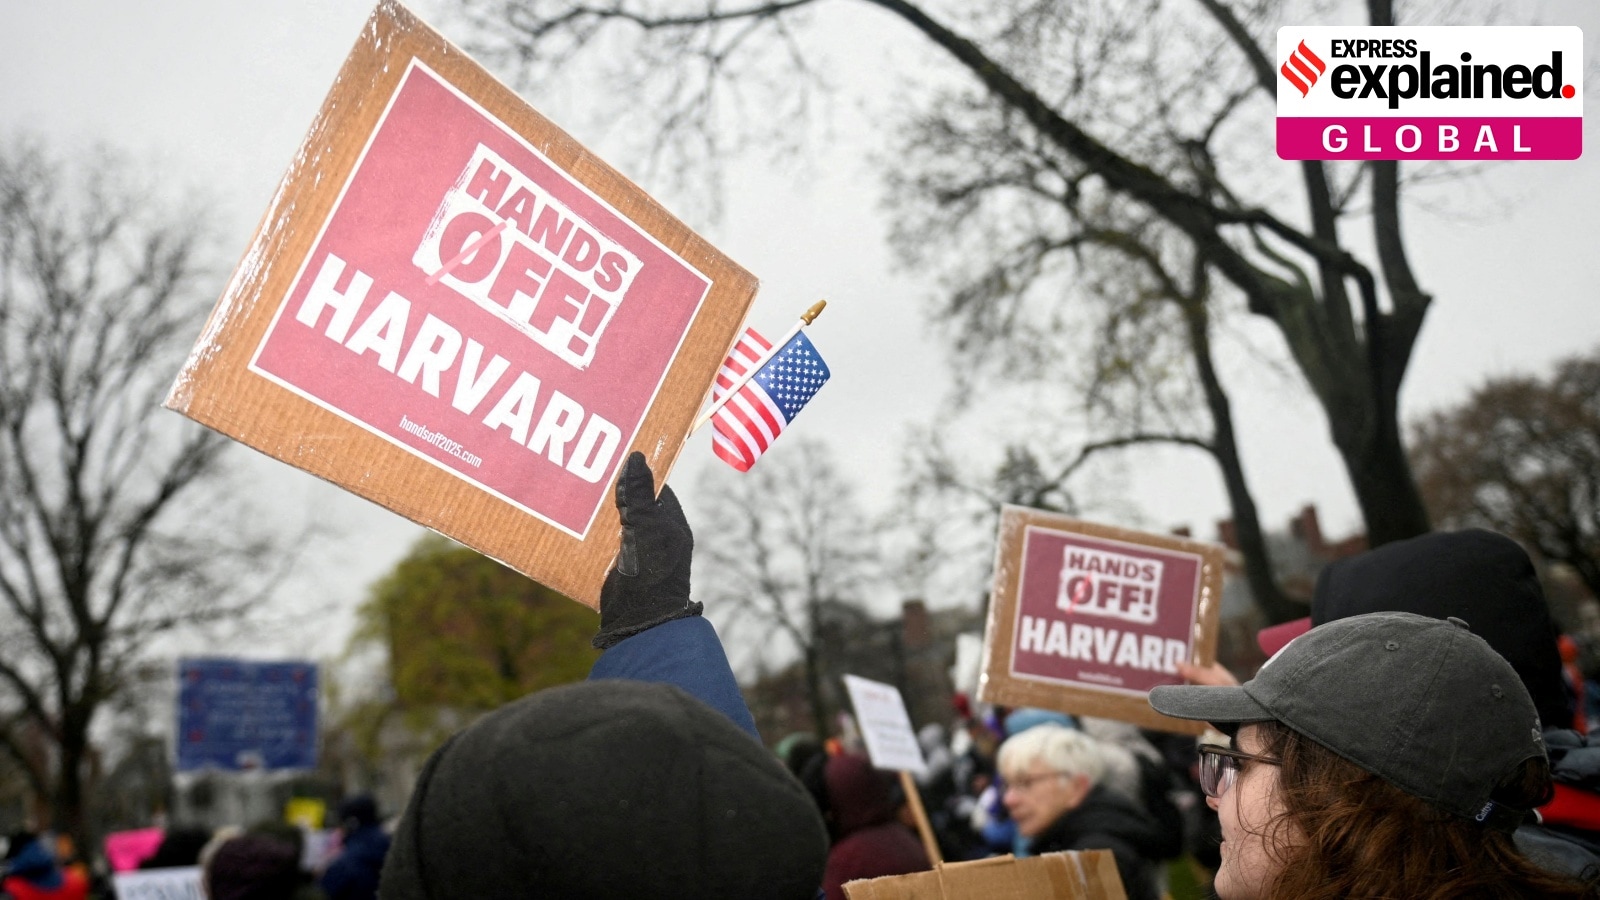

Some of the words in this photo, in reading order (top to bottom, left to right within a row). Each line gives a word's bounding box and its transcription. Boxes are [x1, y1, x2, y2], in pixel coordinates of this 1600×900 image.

[464, 158, 629, 294] HANDS
[296, 253, 622, 484] HARVARD
[399, 414, 483, 468] handsoff2025.com
[1068, 552, 1156, 581] HANDS
[1020, 615, 1187, 674] HARVARD
